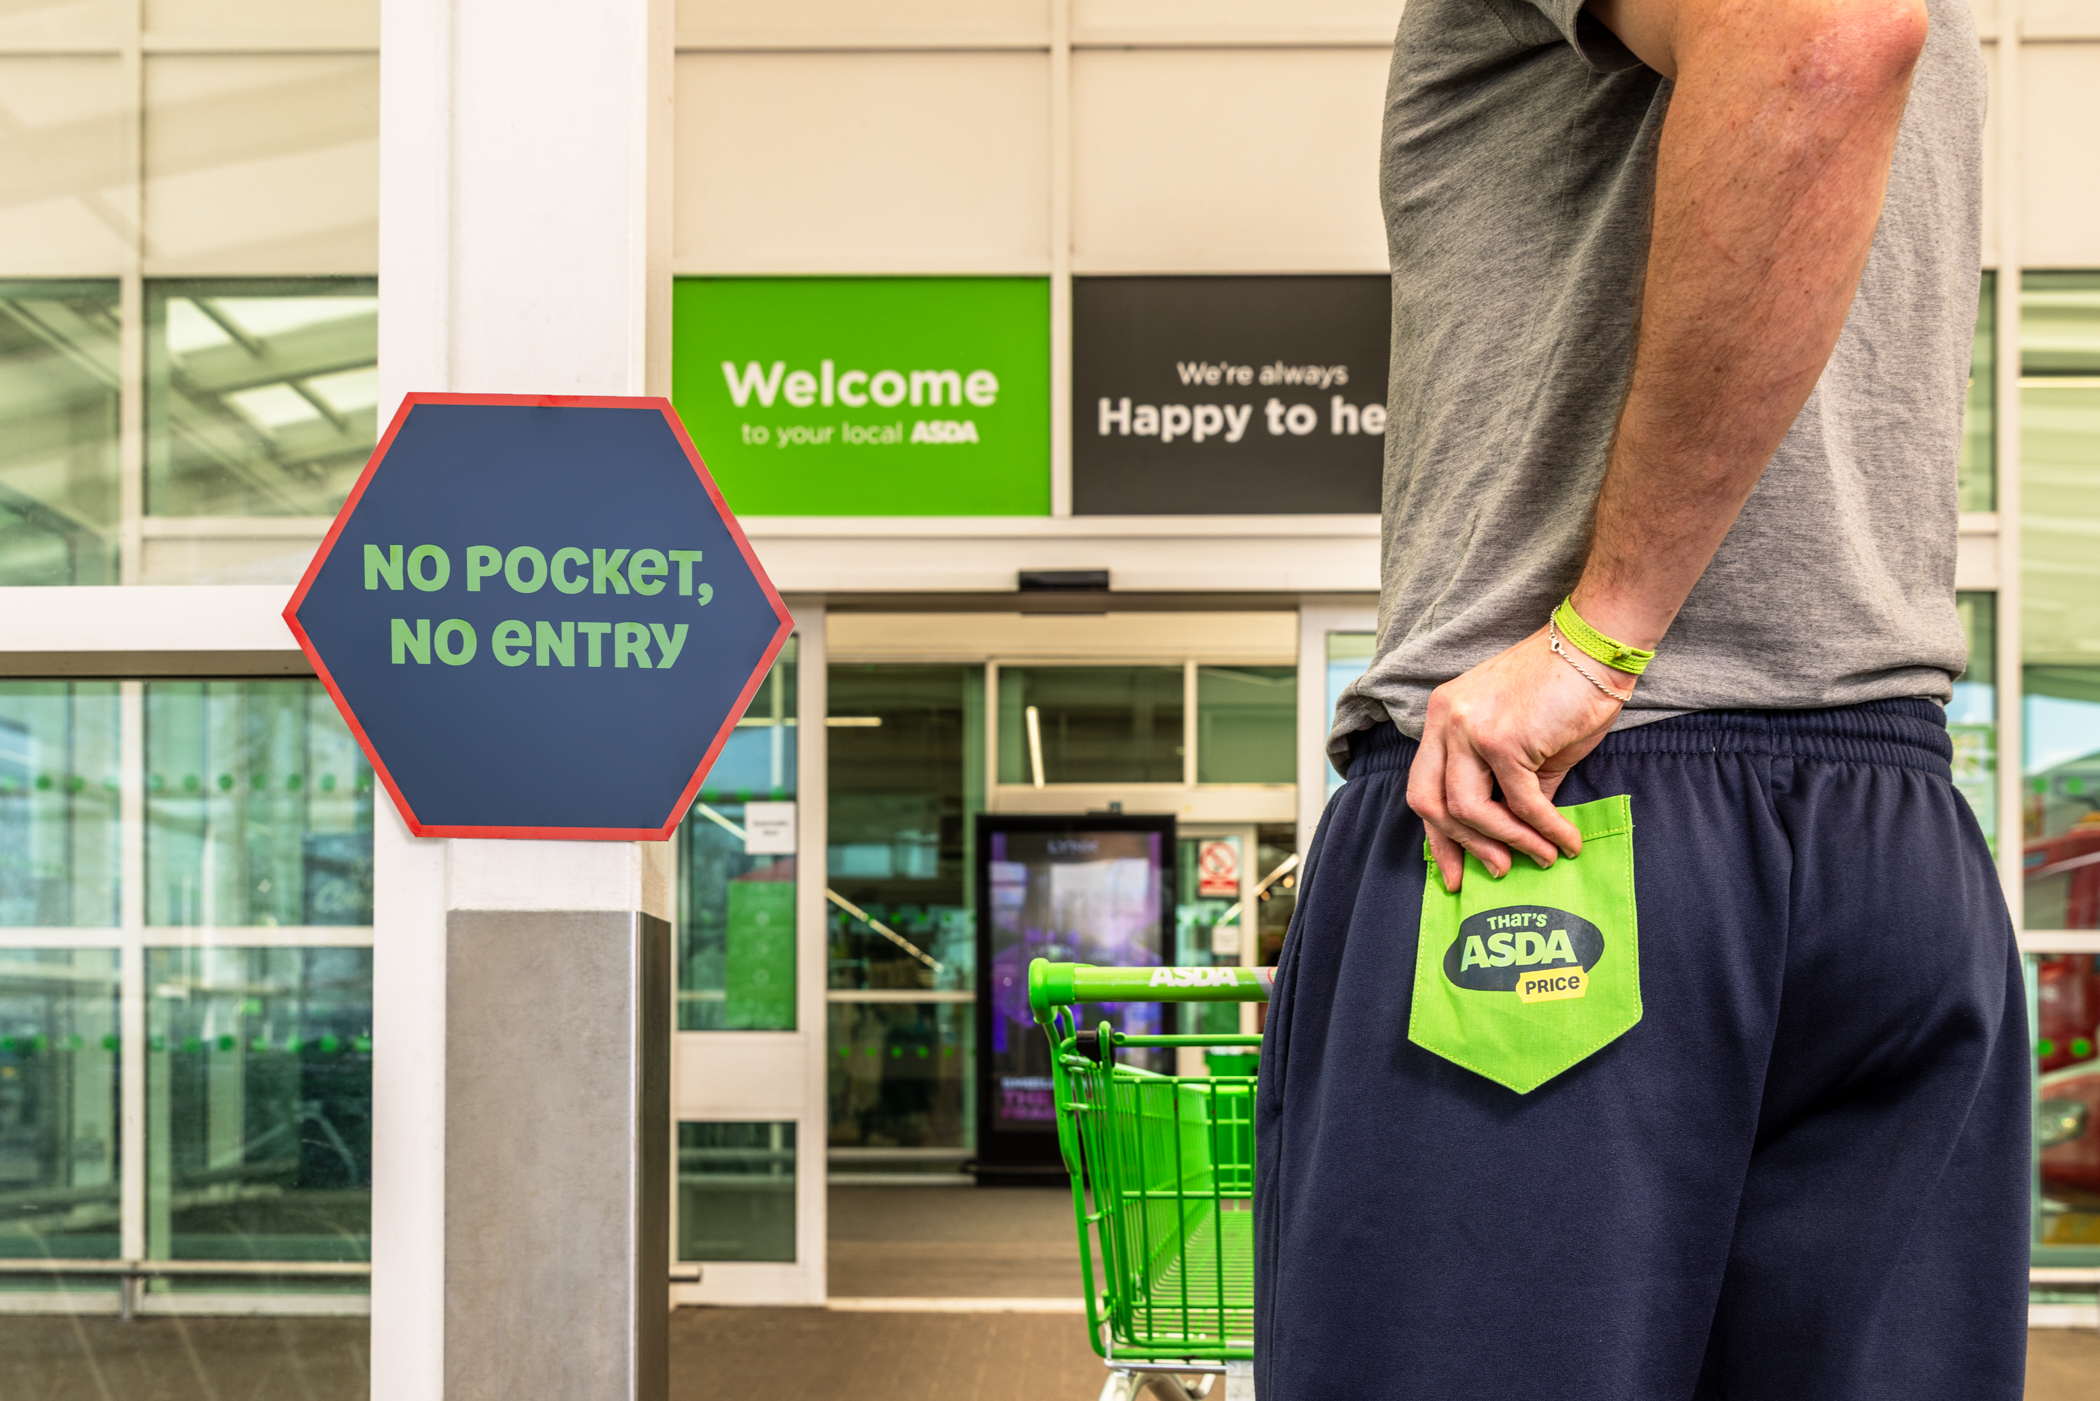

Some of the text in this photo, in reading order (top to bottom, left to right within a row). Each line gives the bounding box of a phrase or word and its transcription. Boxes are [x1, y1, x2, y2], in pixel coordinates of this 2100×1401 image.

[721, 359, 999, 407] Welcome
[1176, 360, 1349, 390] We're always
[741, 420, 979, 449] to your local ASDA
[1098, 397, 1253, 443] Happy
[1264, 398, 1318, 436] to
[363, 544, 451, 592] NO
[391, 618, 477, 666] NO
[1460, 929, 1578, 973] ASDA
[1149, 967, 1239, 987] ASDA
